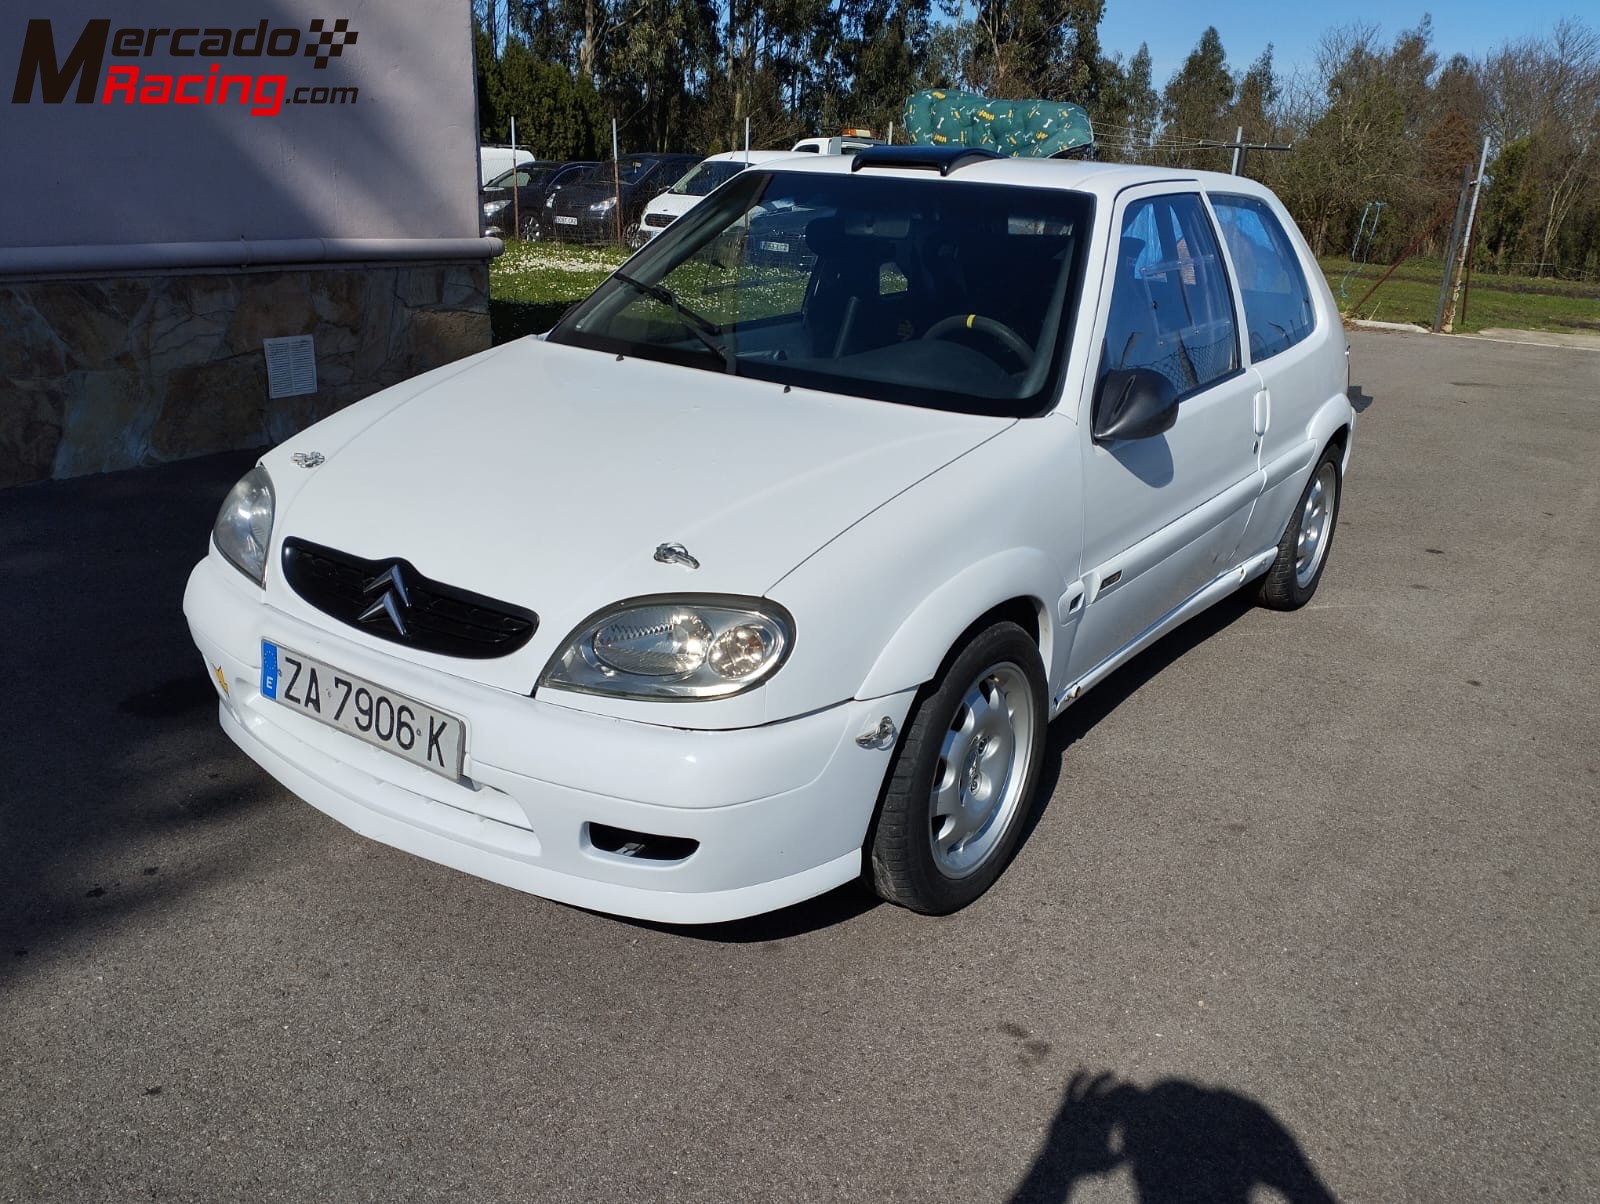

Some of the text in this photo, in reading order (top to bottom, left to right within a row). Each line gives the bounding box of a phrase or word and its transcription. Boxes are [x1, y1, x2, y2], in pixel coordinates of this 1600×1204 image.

[266, 676, 274, 690] E
[284, 657, 448, 768] ZA 7906 K
